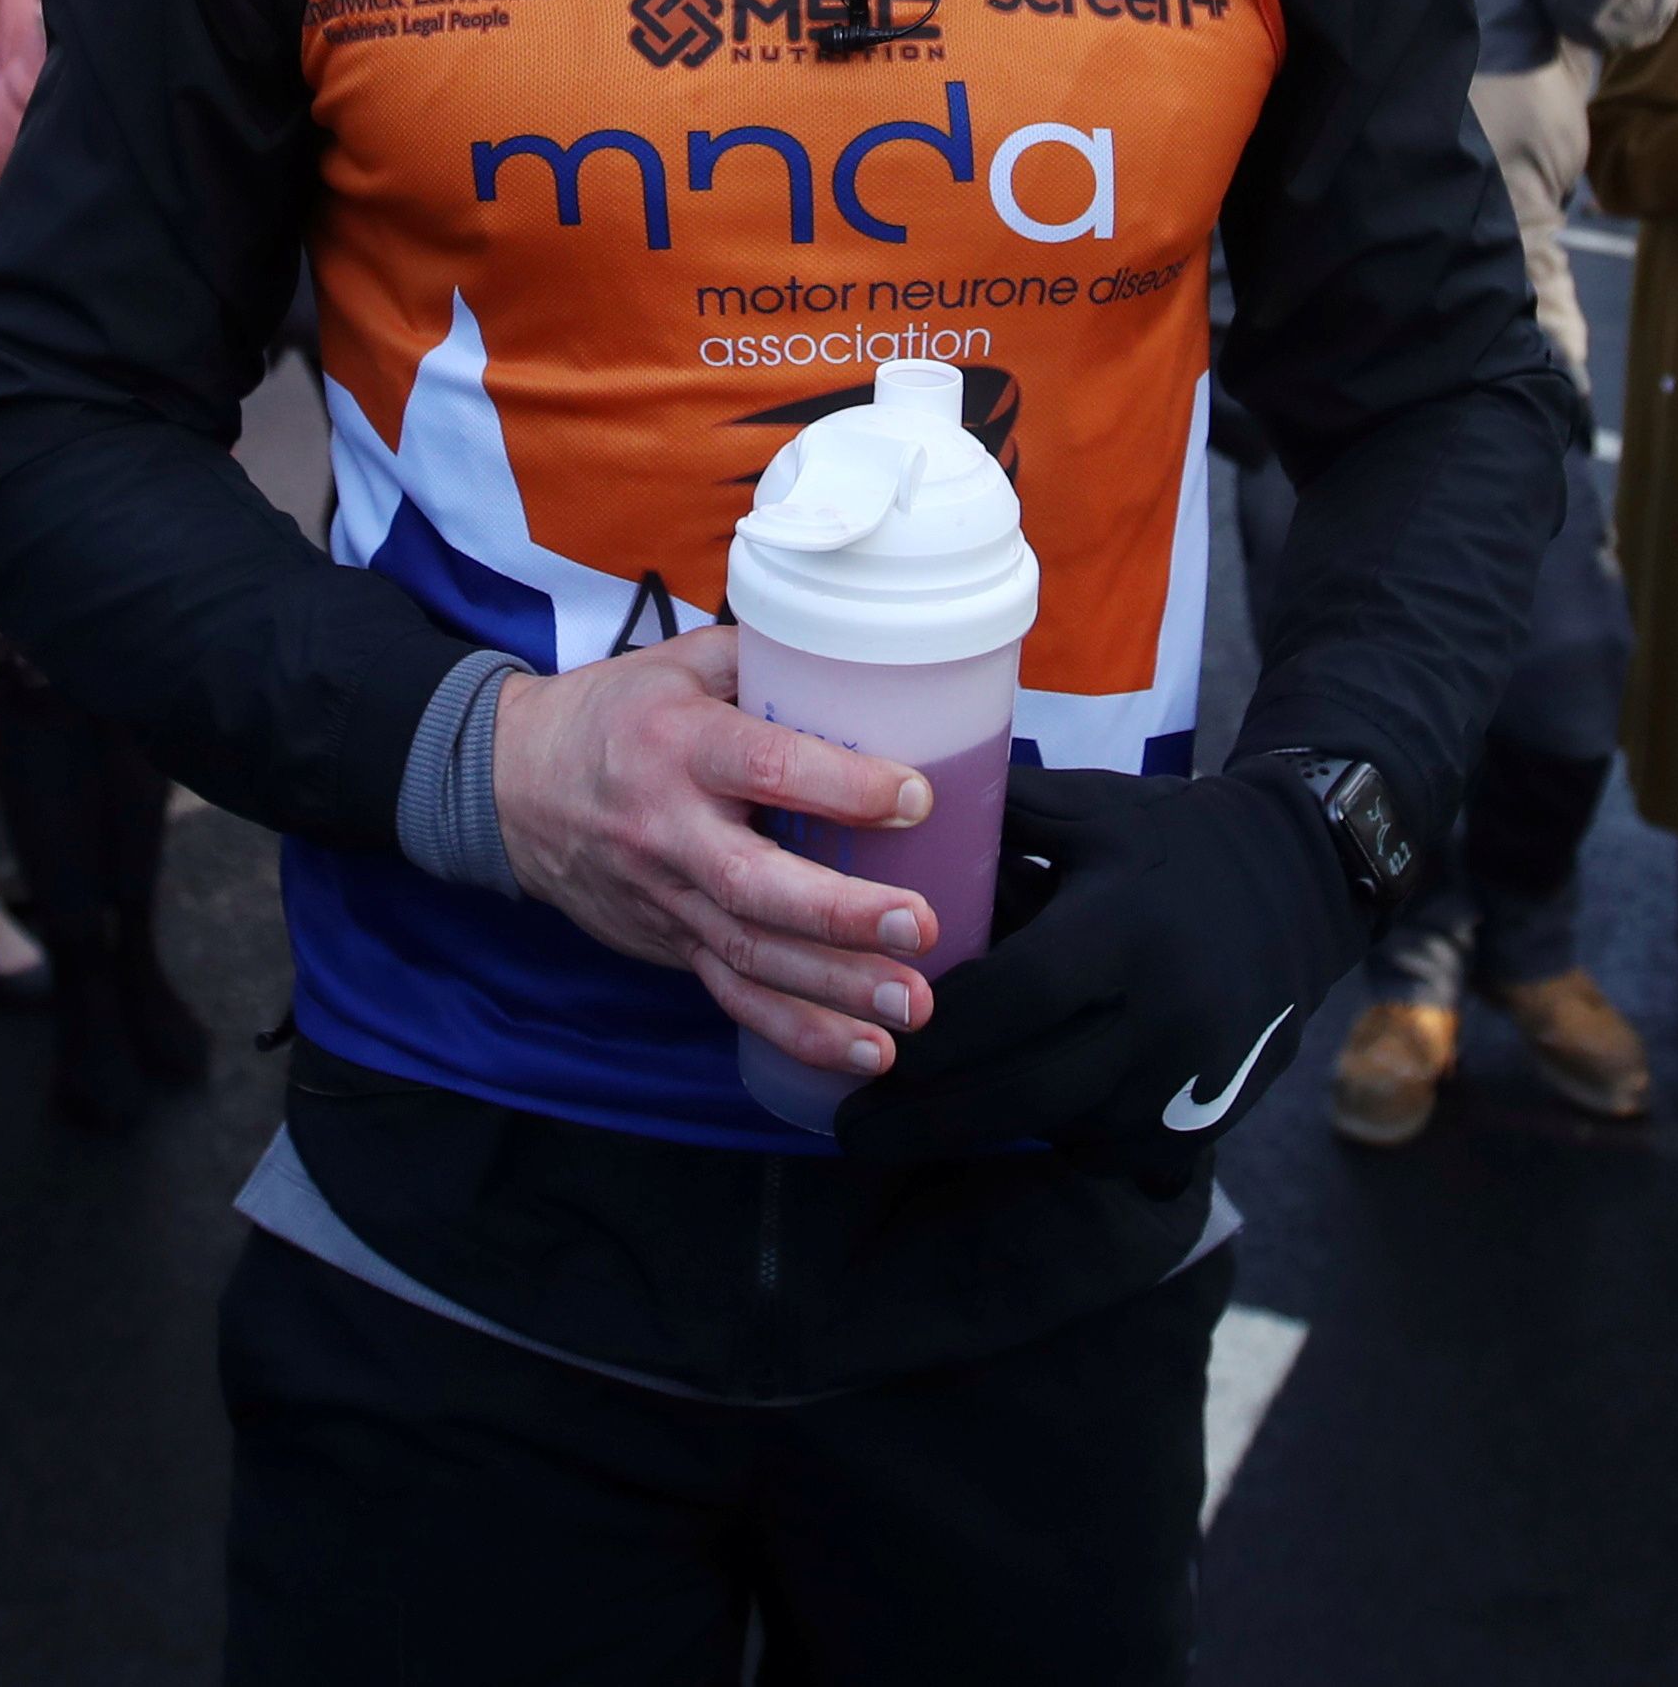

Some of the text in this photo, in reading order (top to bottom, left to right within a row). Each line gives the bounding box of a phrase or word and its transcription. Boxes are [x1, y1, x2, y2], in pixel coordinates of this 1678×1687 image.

[402, 13, 443, 37] Legal
[450, 8, 511, 32] People
[471, 81, 1114, 249] mnda
[697, 275, 856, 316] motor
[868, 275, 1079, 311] neurone
[699, 323, 993, 368] association
